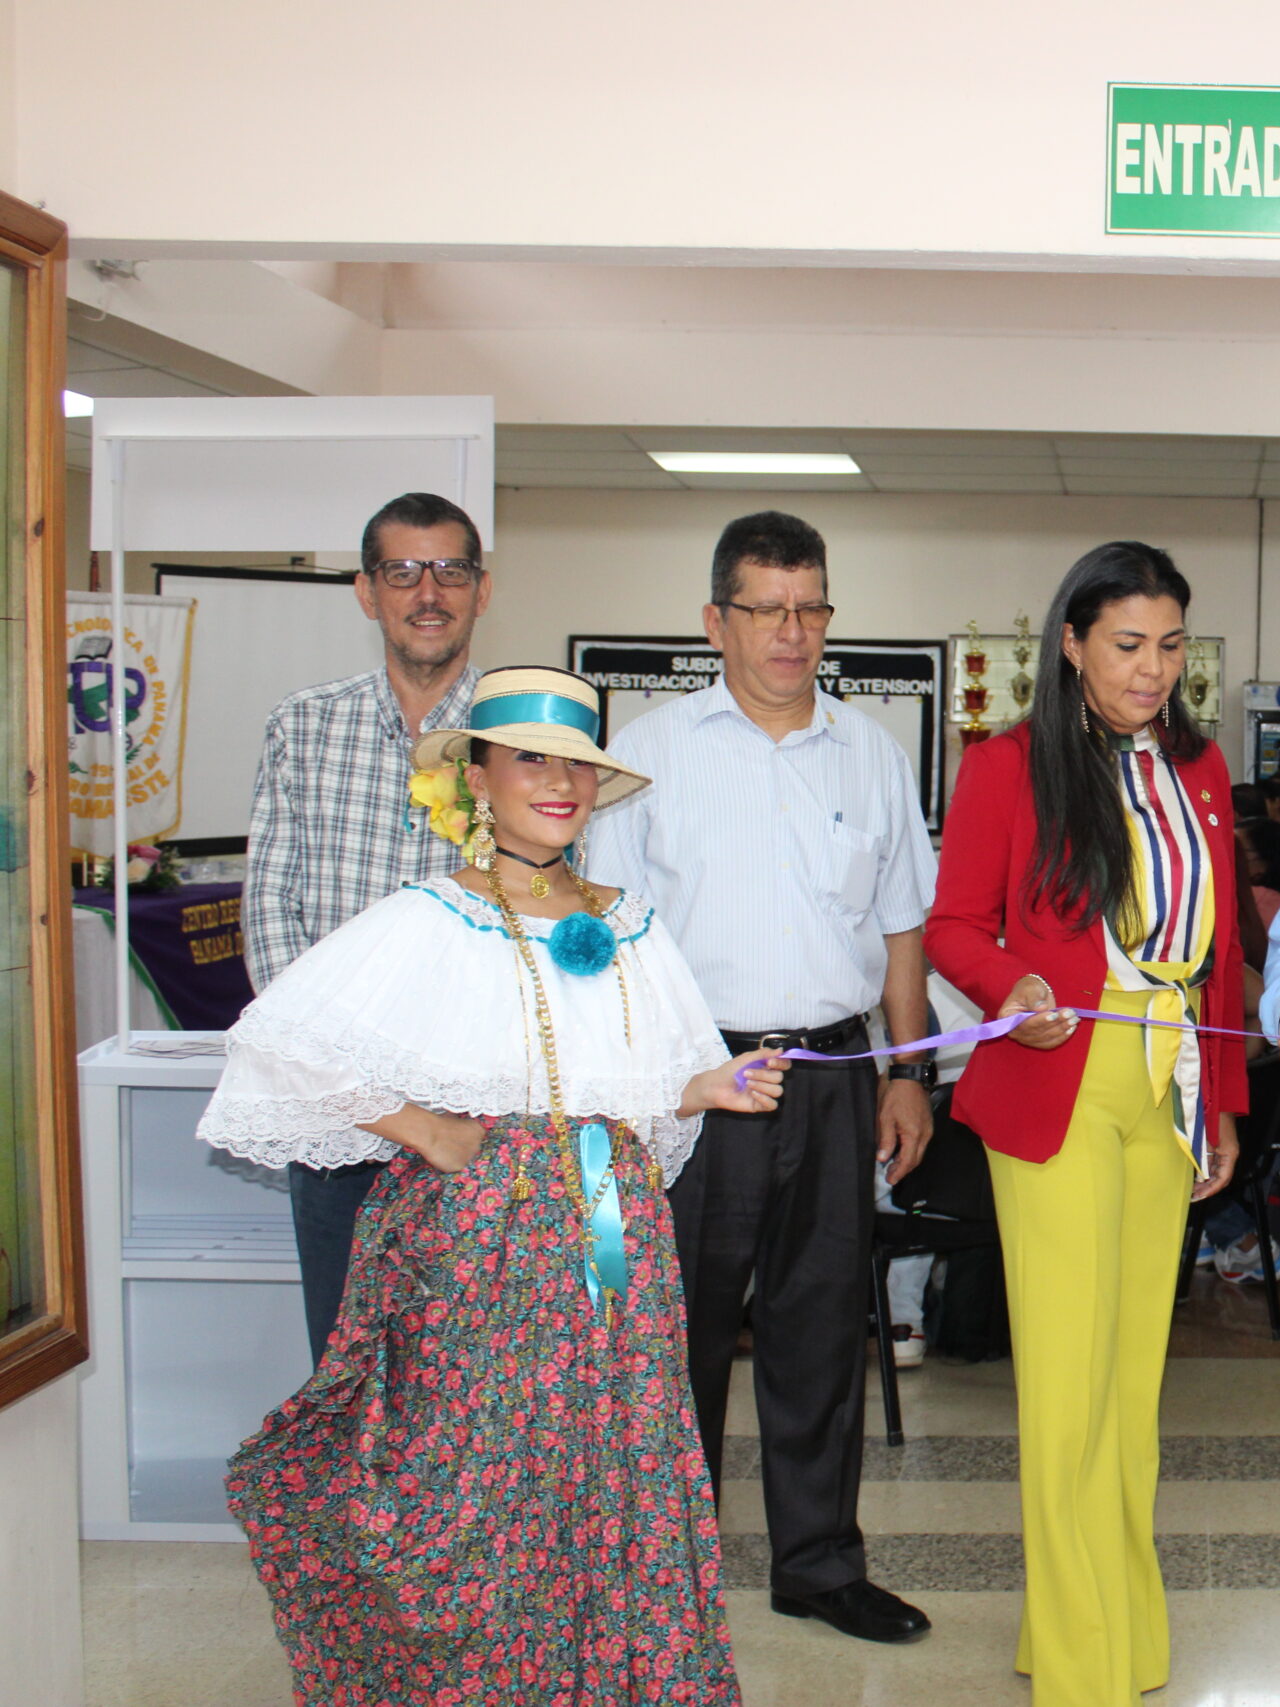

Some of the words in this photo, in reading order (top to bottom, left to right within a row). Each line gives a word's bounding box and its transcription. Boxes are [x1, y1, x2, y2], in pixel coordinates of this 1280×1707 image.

[817, 660, 840, 676] DE
[823, 677, 836, 692] Y
[838, 677, 934, 694] EXTENSION
